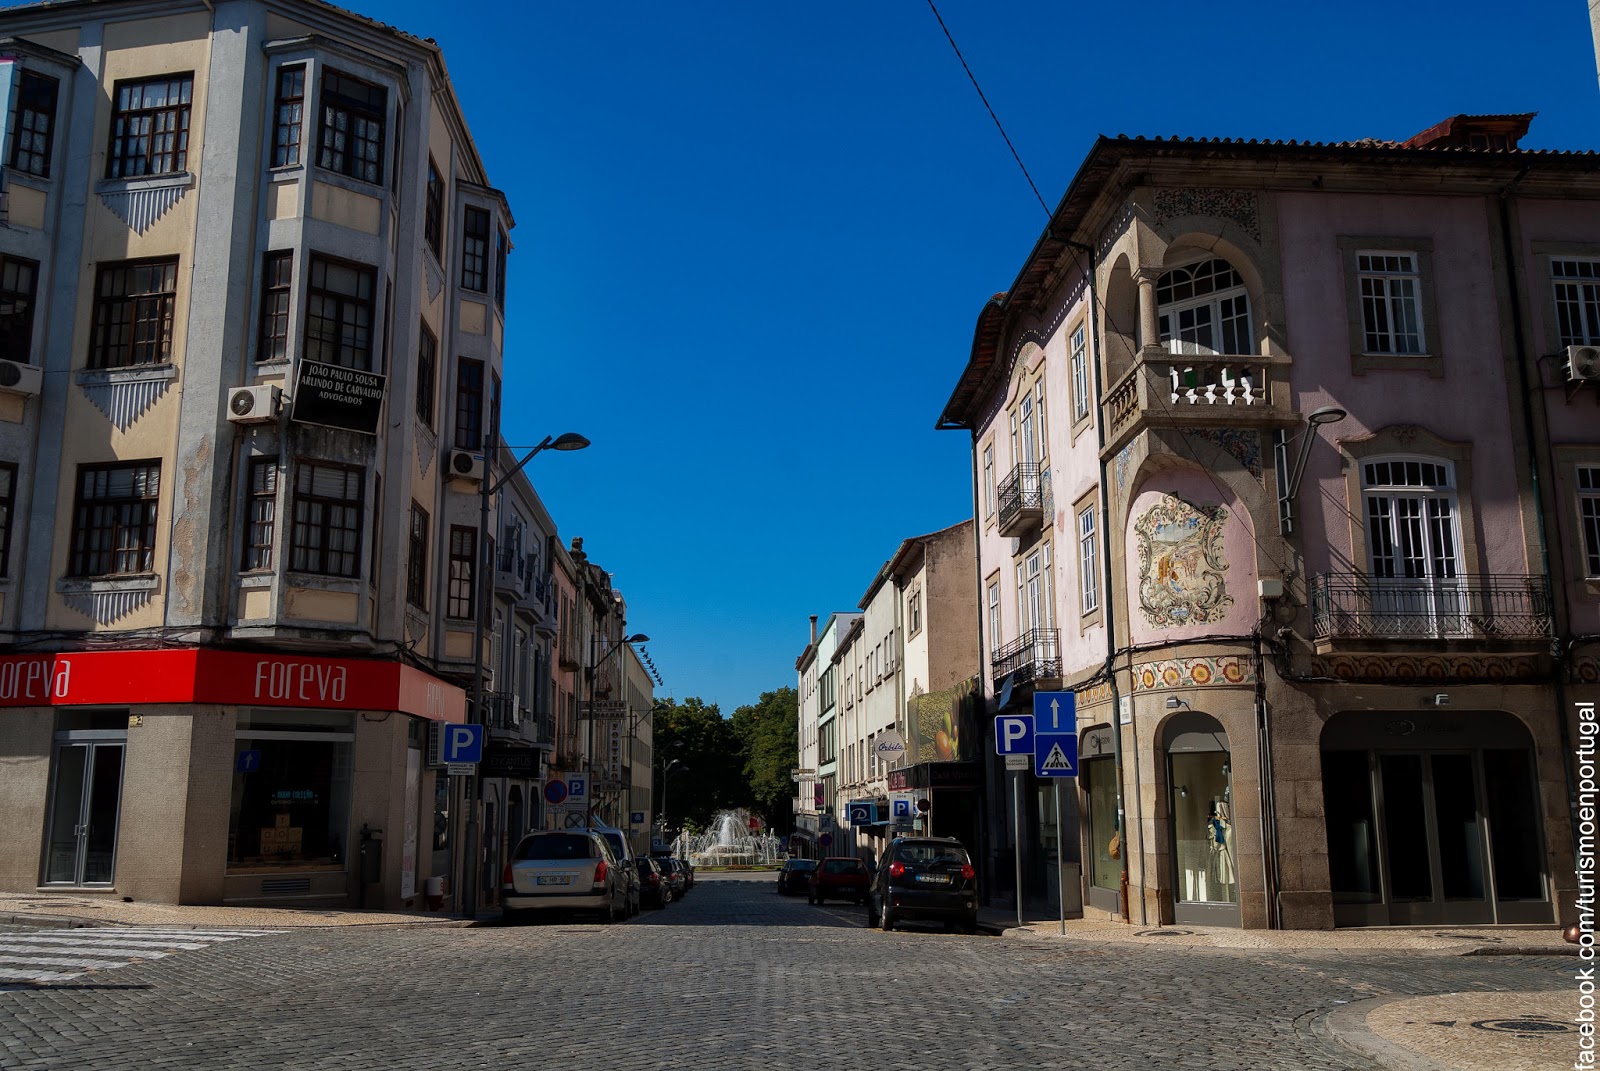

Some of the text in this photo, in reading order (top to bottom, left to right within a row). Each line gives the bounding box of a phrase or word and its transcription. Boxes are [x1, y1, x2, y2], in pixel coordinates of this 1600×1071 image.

[308, 364, 378, 386] JOÃO PAULO SOUSA
[301, 375, 382, 399] ARLINDO DE CARVALHO
[318, 391, 363, 405] ADVOGADOS
[451, 727, 475, 759] P
[1003, 718, 1027, 752] P
[571, 782, 581, 794] P
[896, 803, 906, 815] P
